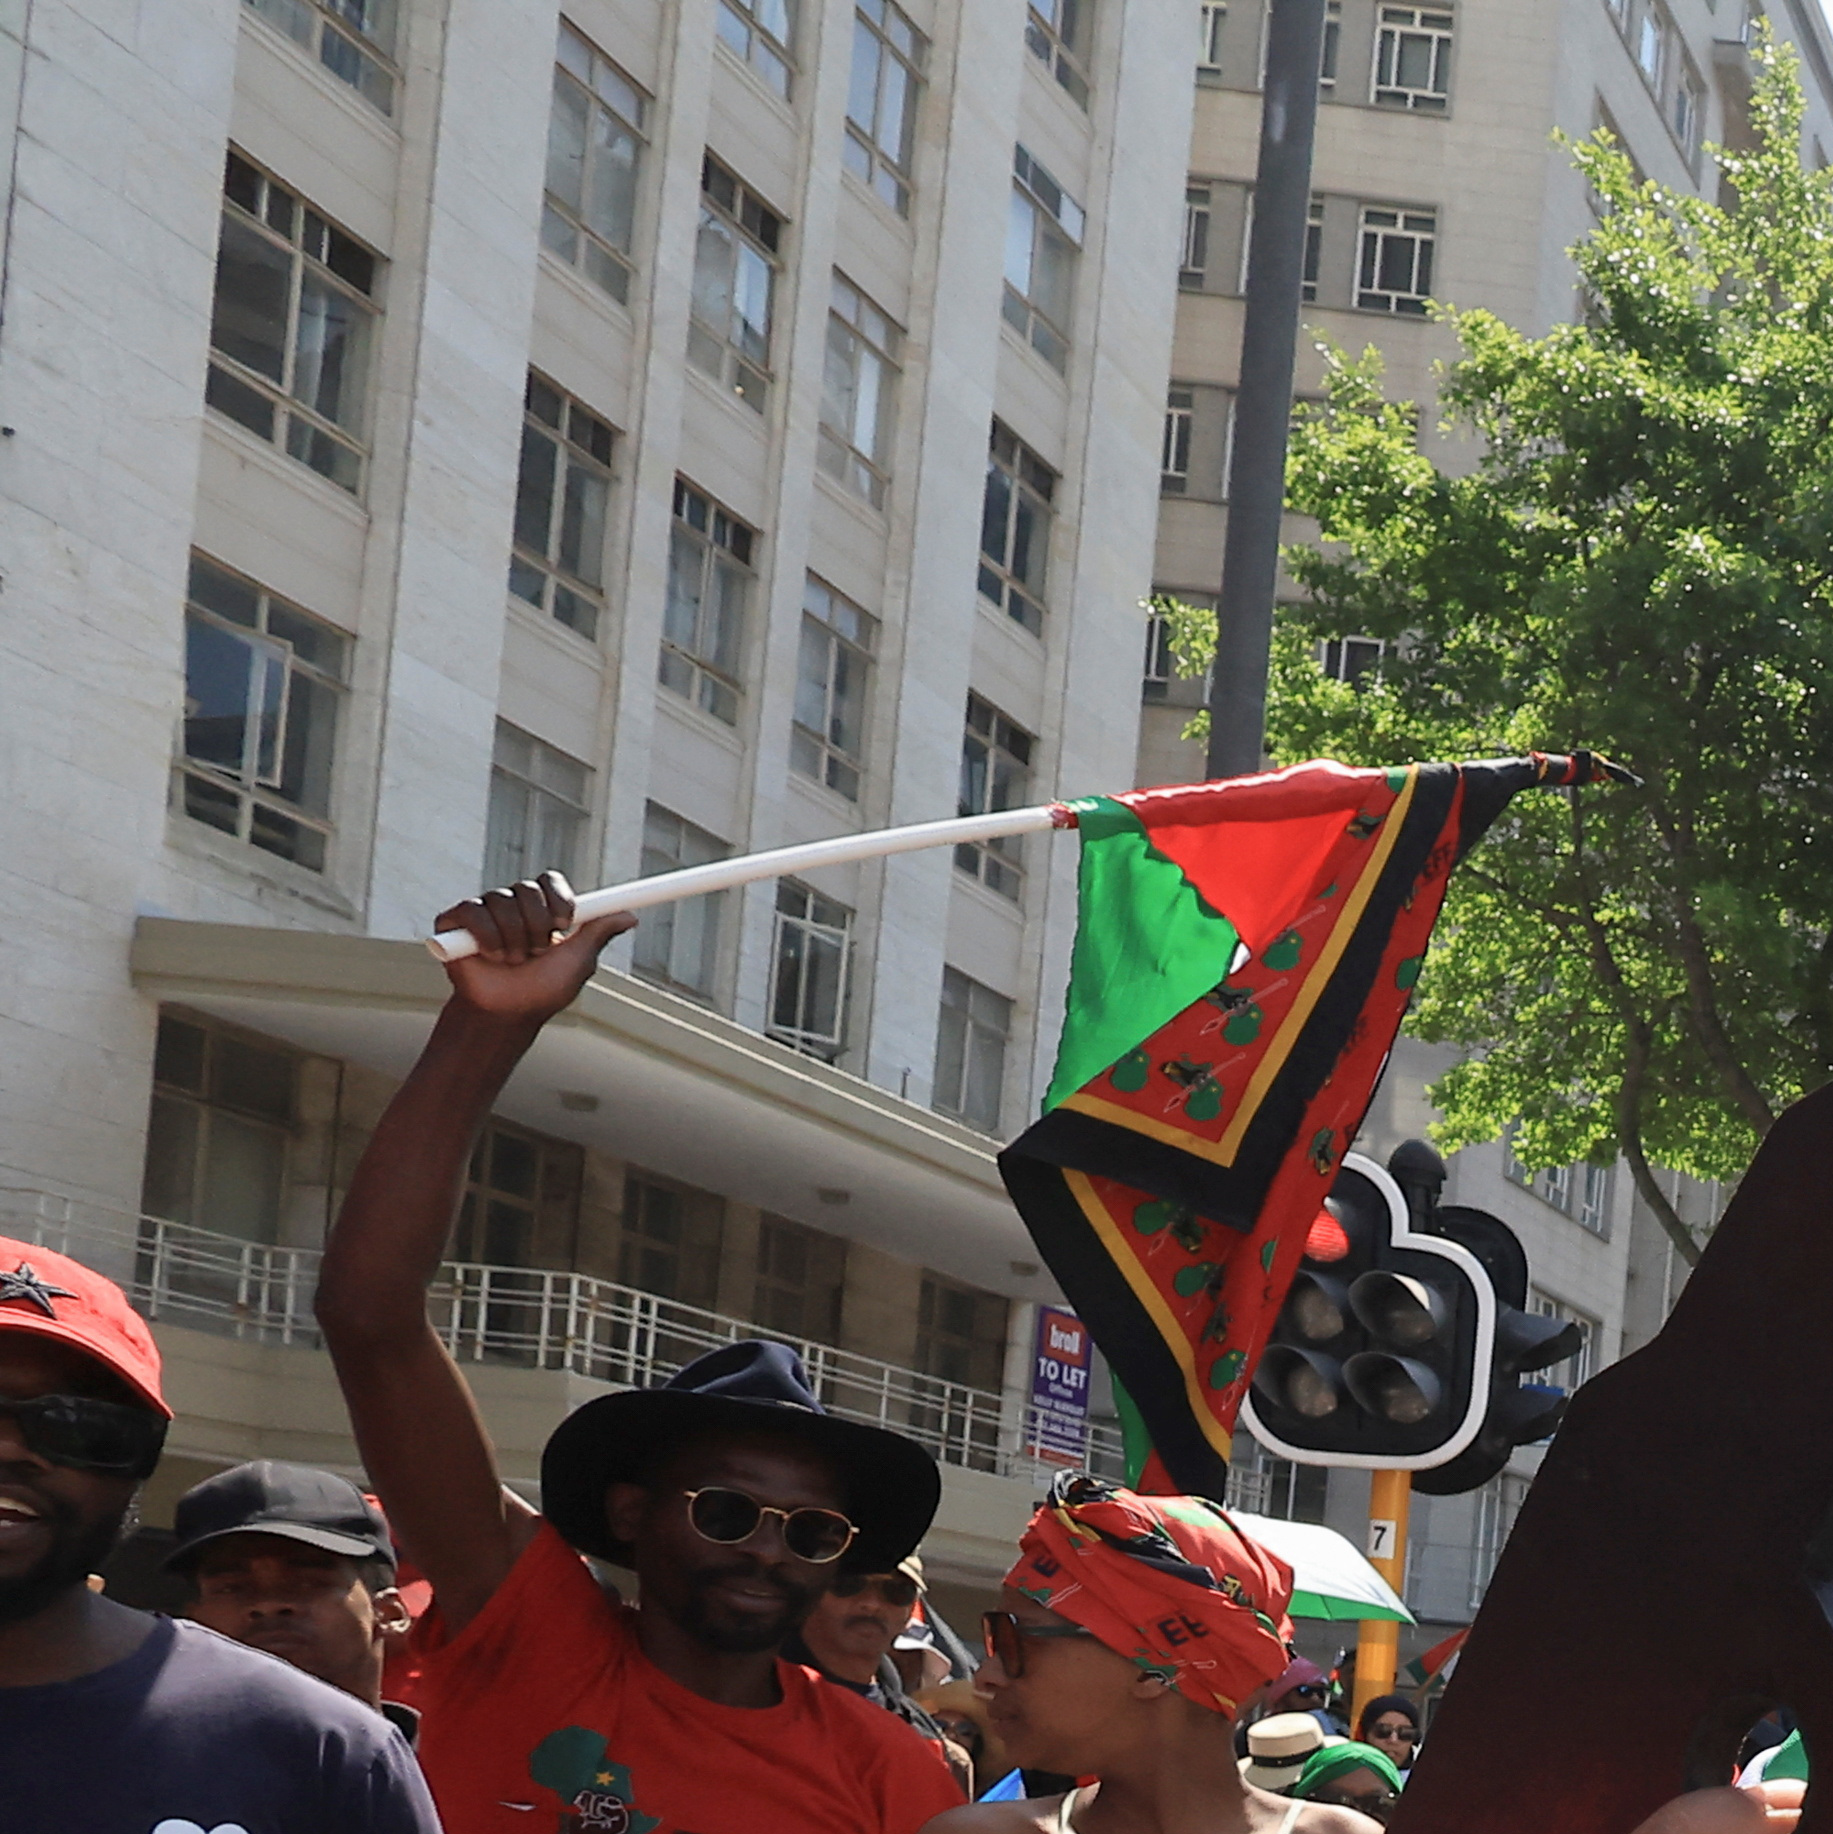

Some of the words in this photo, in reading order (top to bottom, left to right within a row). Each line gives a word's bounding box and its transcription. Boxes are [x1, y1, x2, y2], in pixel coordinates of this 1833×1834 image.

[1050, 1324, 1080, 1355] broll
[1038, 1357, 1059, 1380] TO
[1062, 1366, 1087, 1390] LET
[1373, 1526, 1387, 1551] 7
